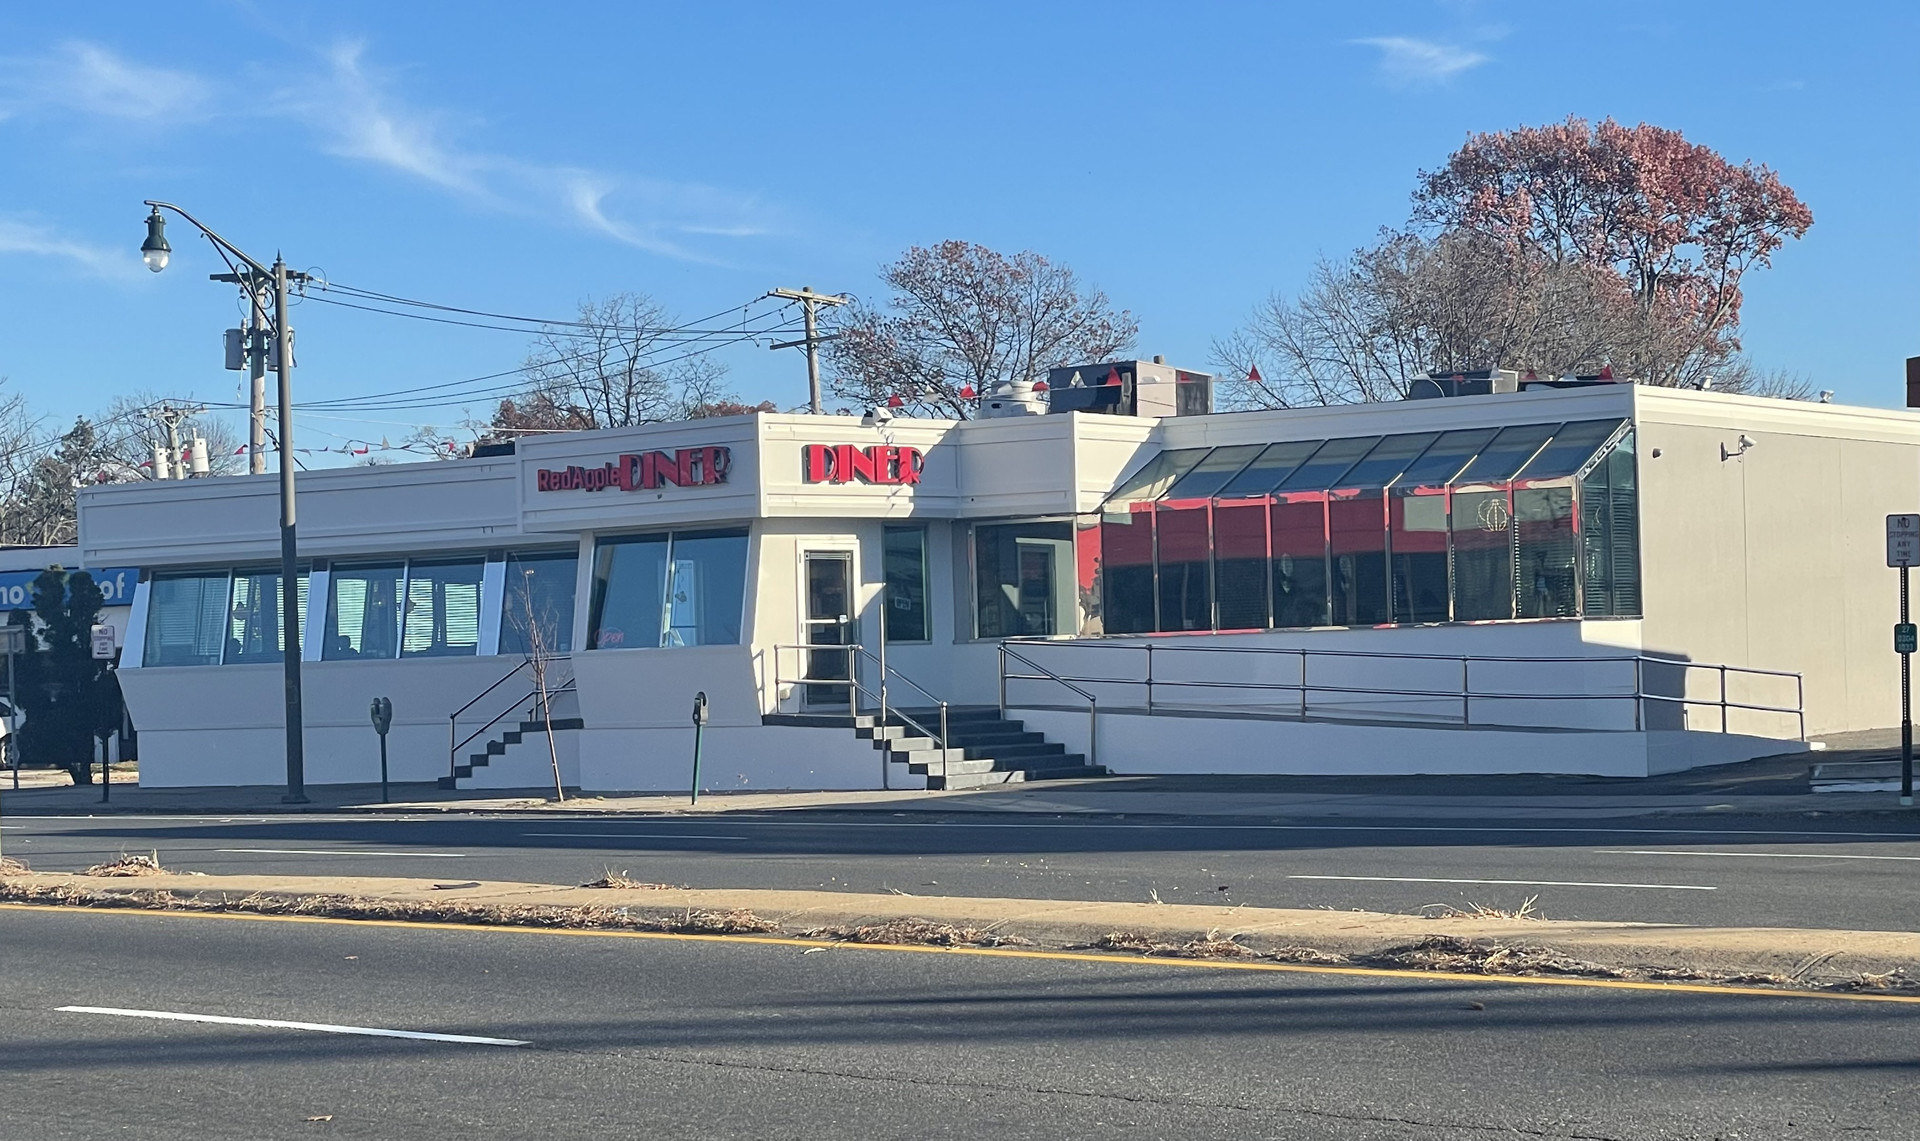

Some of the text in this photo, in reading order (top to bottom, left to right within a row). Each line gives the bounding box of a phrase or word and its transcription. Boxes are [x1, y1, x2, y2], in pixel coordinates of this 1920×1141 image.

[619, 447, 730, 491] DINER
[801, 444, 925, 485] DINER
[1897, 518, 1910, 528] NO
